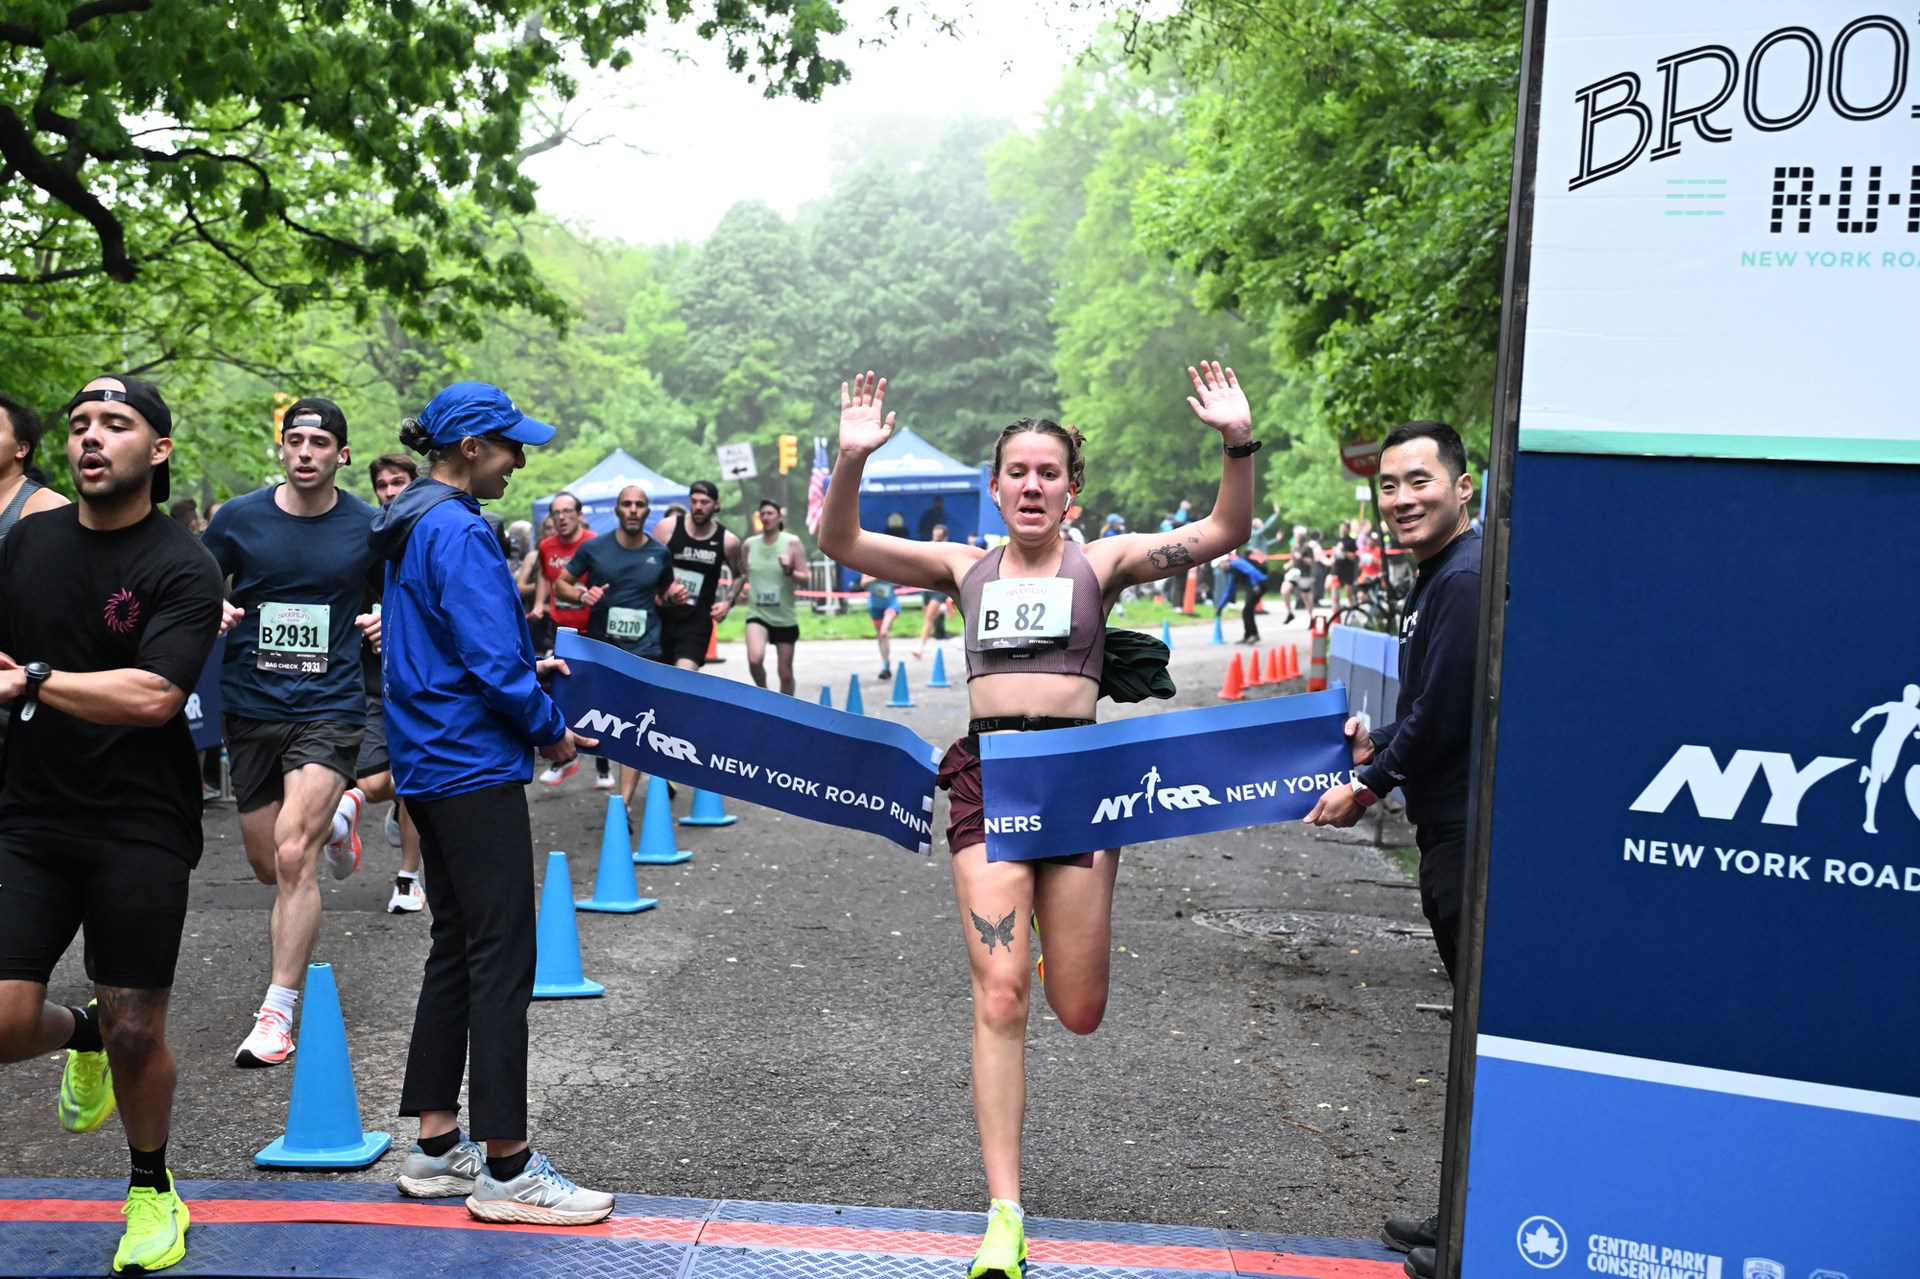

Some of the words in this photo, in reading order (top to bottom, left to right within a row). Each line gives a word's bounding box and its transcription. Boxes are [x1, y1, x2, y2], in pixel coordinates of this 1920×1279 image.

[1568, 14, 1920, 192] BROO
[1741, 251, 1798, 268] NEW
[1806, 251, 1872, 268] YORK
[618, 619, 641, 634] 2170
[985, 609, 999, 631] B
[1014, 602, 1046, 631] 82
[275, 624, 319, 648] 2931
[265, 661, 277, 669] BAG
[301, 661, 320, 673] 2931
[710, 754, 759, 778] NEW
[765, 768, 820, 797] YORK
[825, 786, 884, 811] ROAD
[1226, 780, 1277, 803] NEW
[1283, 770, 1345, 794] YORK
[1623, 838, 1704, 868] NEW
[1714, 847, 1811, 880] YORK
[1824, 859, 1920, 892] ROAD
[1588, 1234, 1659, 1263] CENTRAL
[1661, 1247, 1706, 1272] PARK
